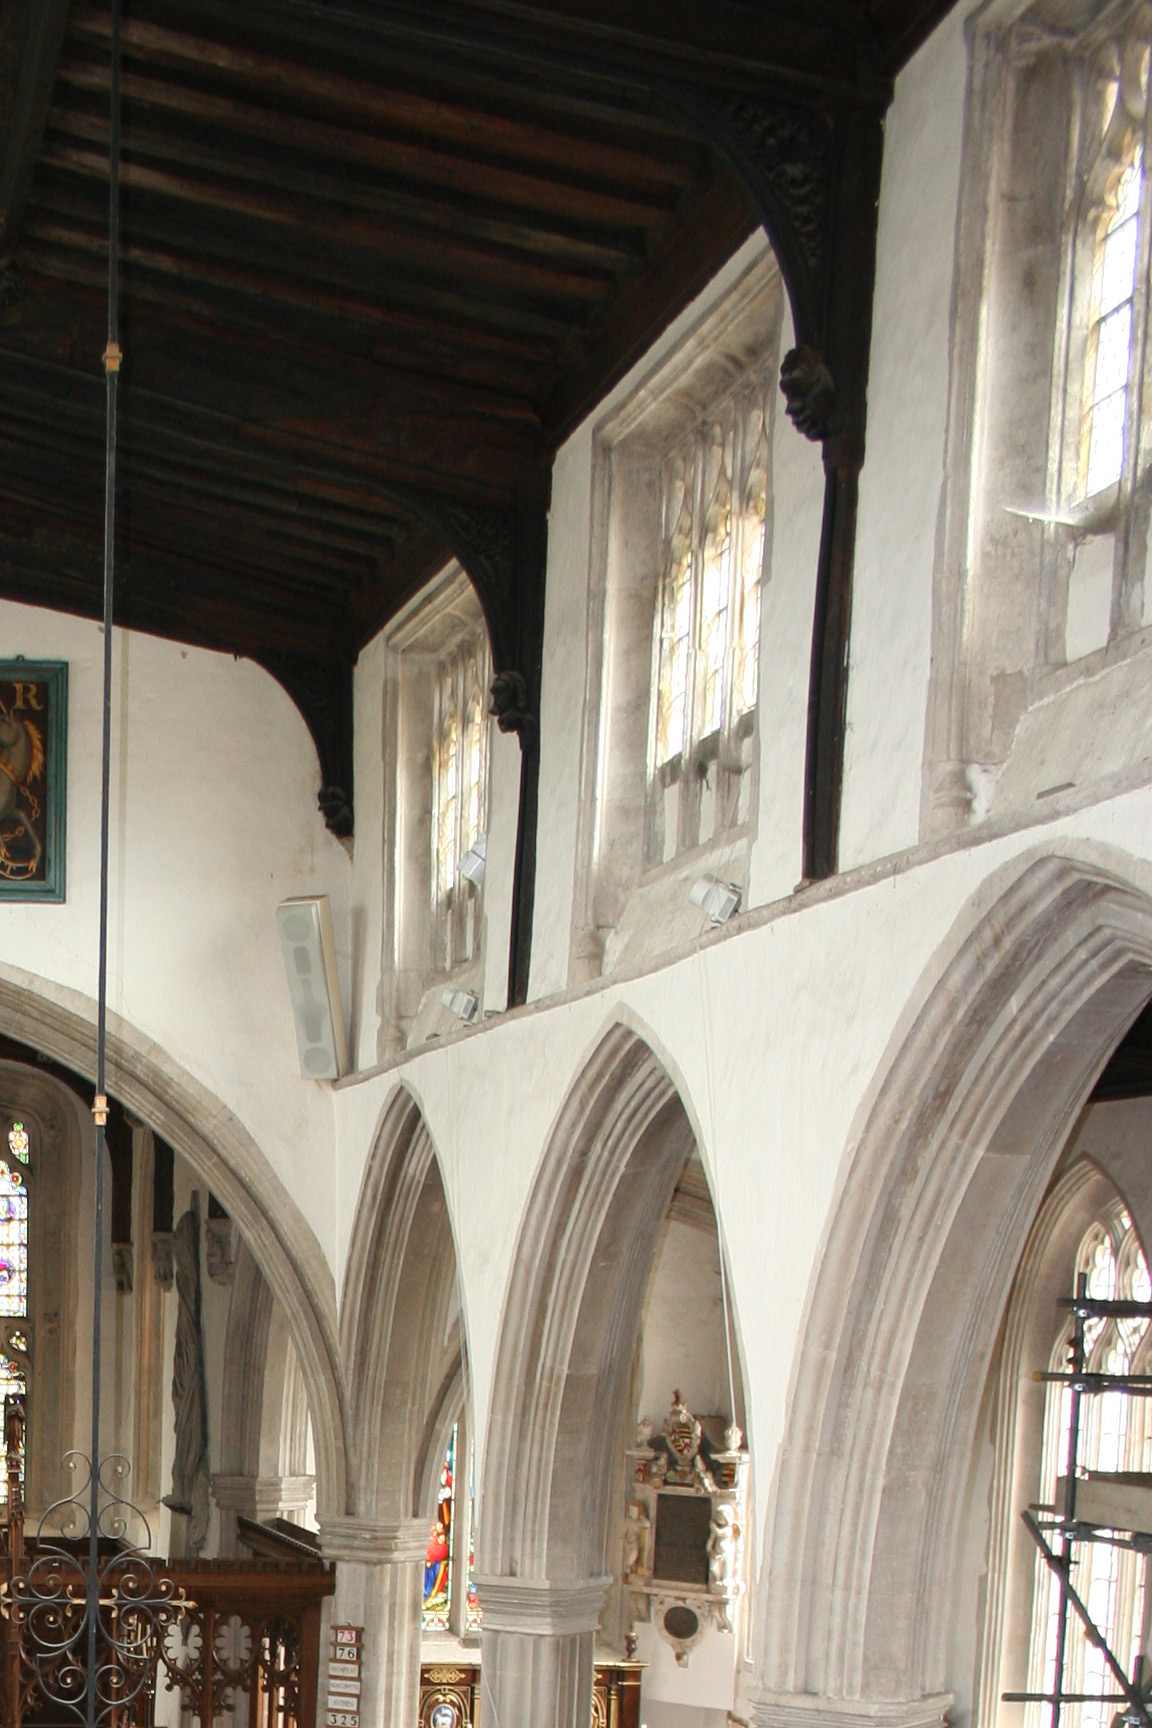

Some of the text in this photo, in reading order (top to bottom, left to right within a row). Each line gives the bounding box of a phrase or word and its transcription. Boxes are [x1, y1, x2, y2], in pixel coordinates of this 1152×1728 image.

[15, 683, 44, 711] R
[338, 1631, 354, 1642] 73
[338, 1648, 355, 1658] 76
[330, 1714, 358, 1726] 325
